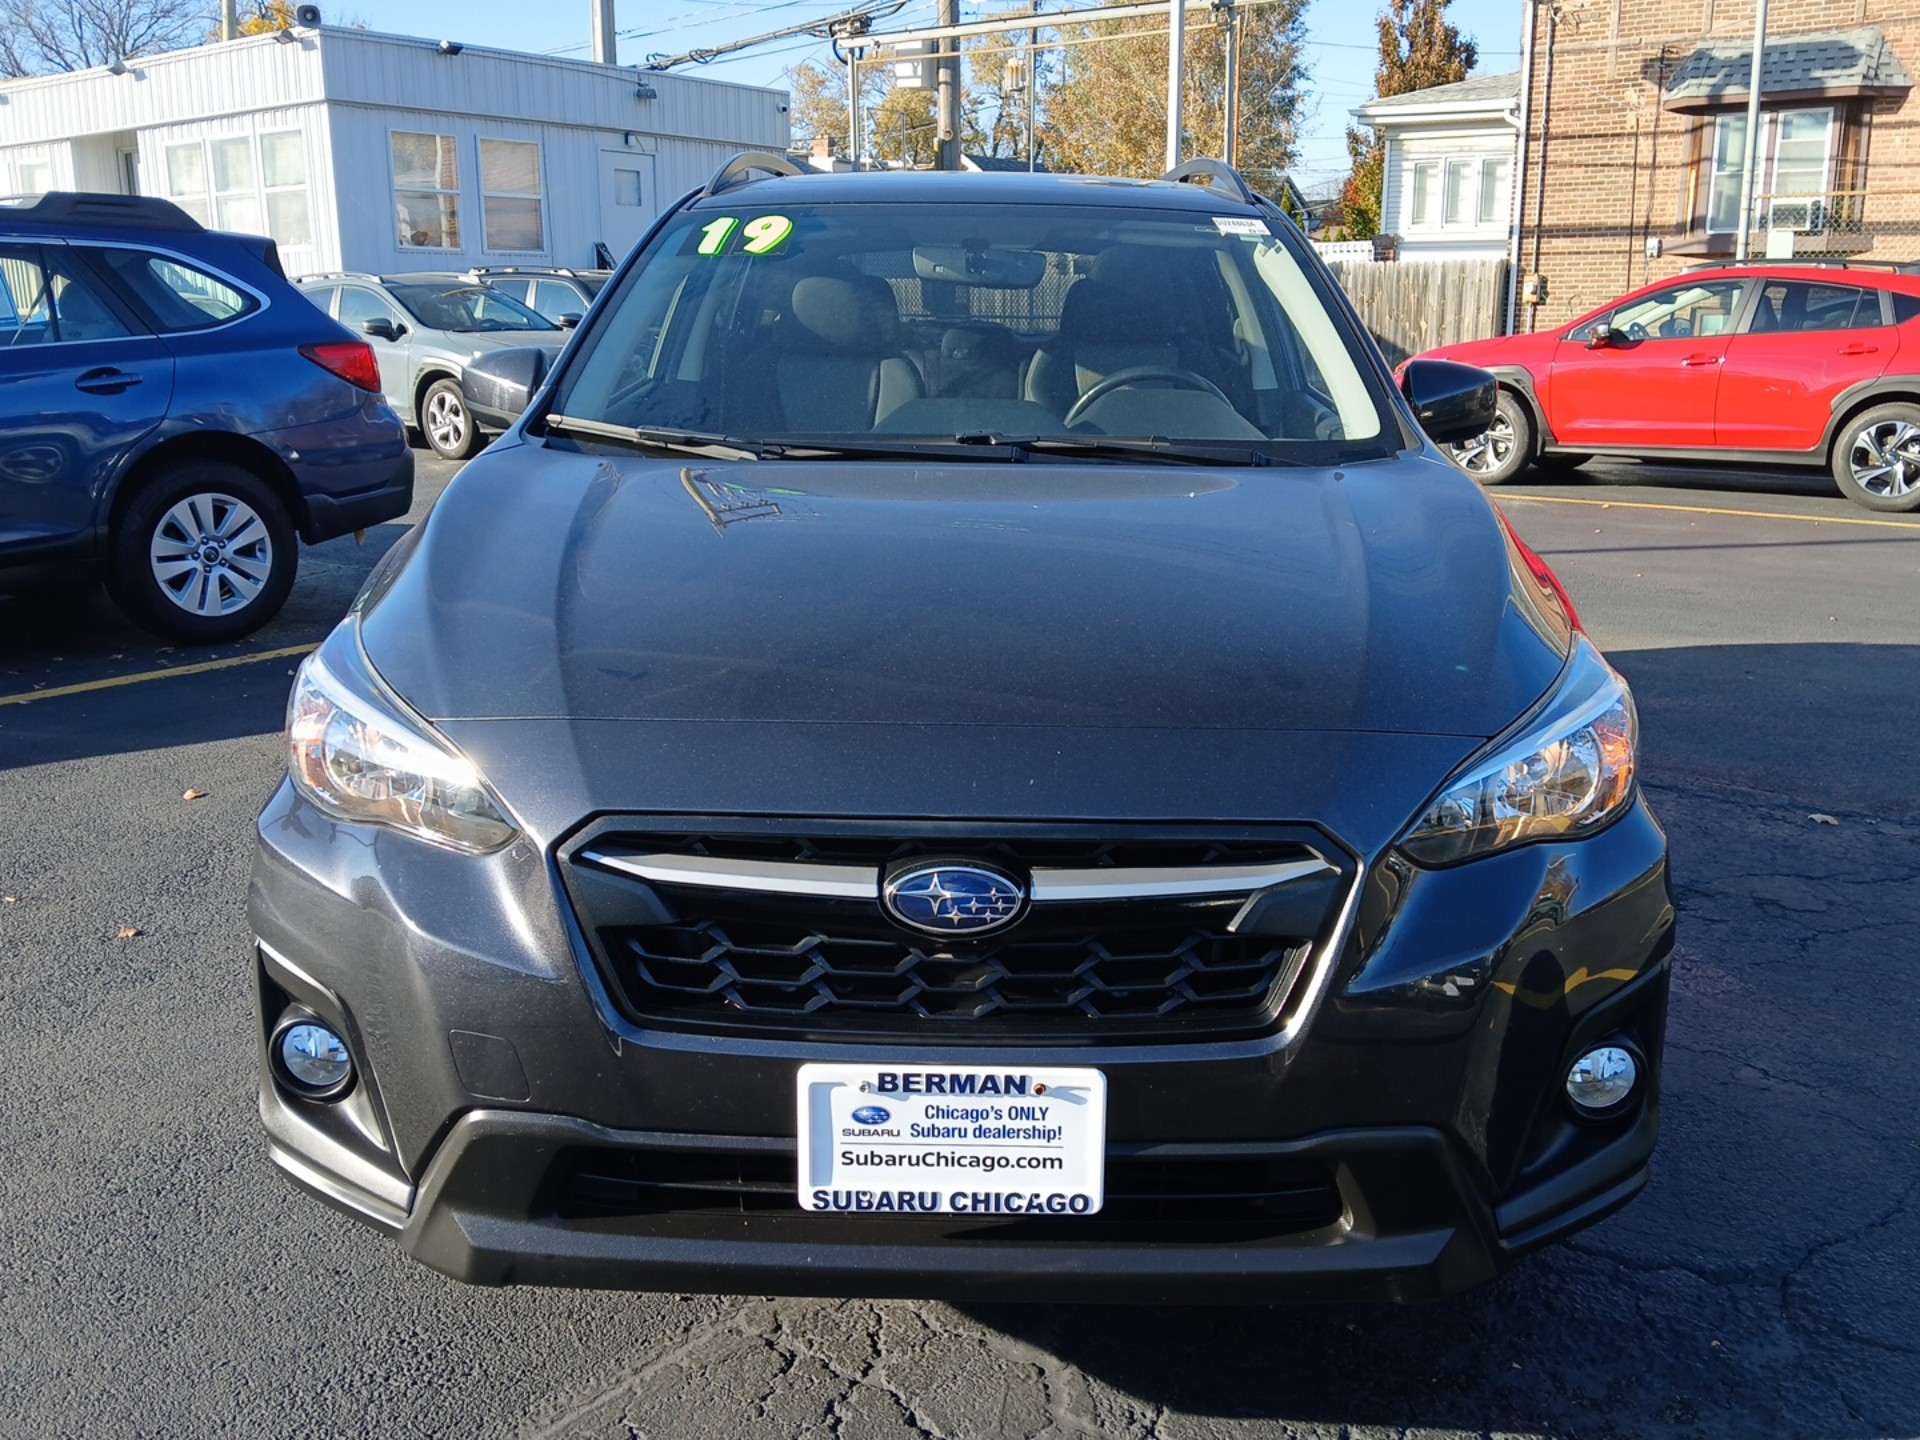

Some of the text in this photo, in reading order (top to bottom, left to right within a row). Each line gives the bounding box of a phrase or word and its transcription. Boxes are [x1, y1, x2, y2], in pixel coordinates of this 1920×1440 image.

[877, 1072, 1027, 1095] BERMAN
[924, 1104, 1049, 1122] Chicago's ONLY
[841, 1128, 901, 1137] SUBARU
[909, 1123, 1062, 1143] Subaru dealership!
[840, 1150, 1063, 1172] SubaruChicago.com
[812, 1190, 1090, 1213] SUBARU CHICAGO
